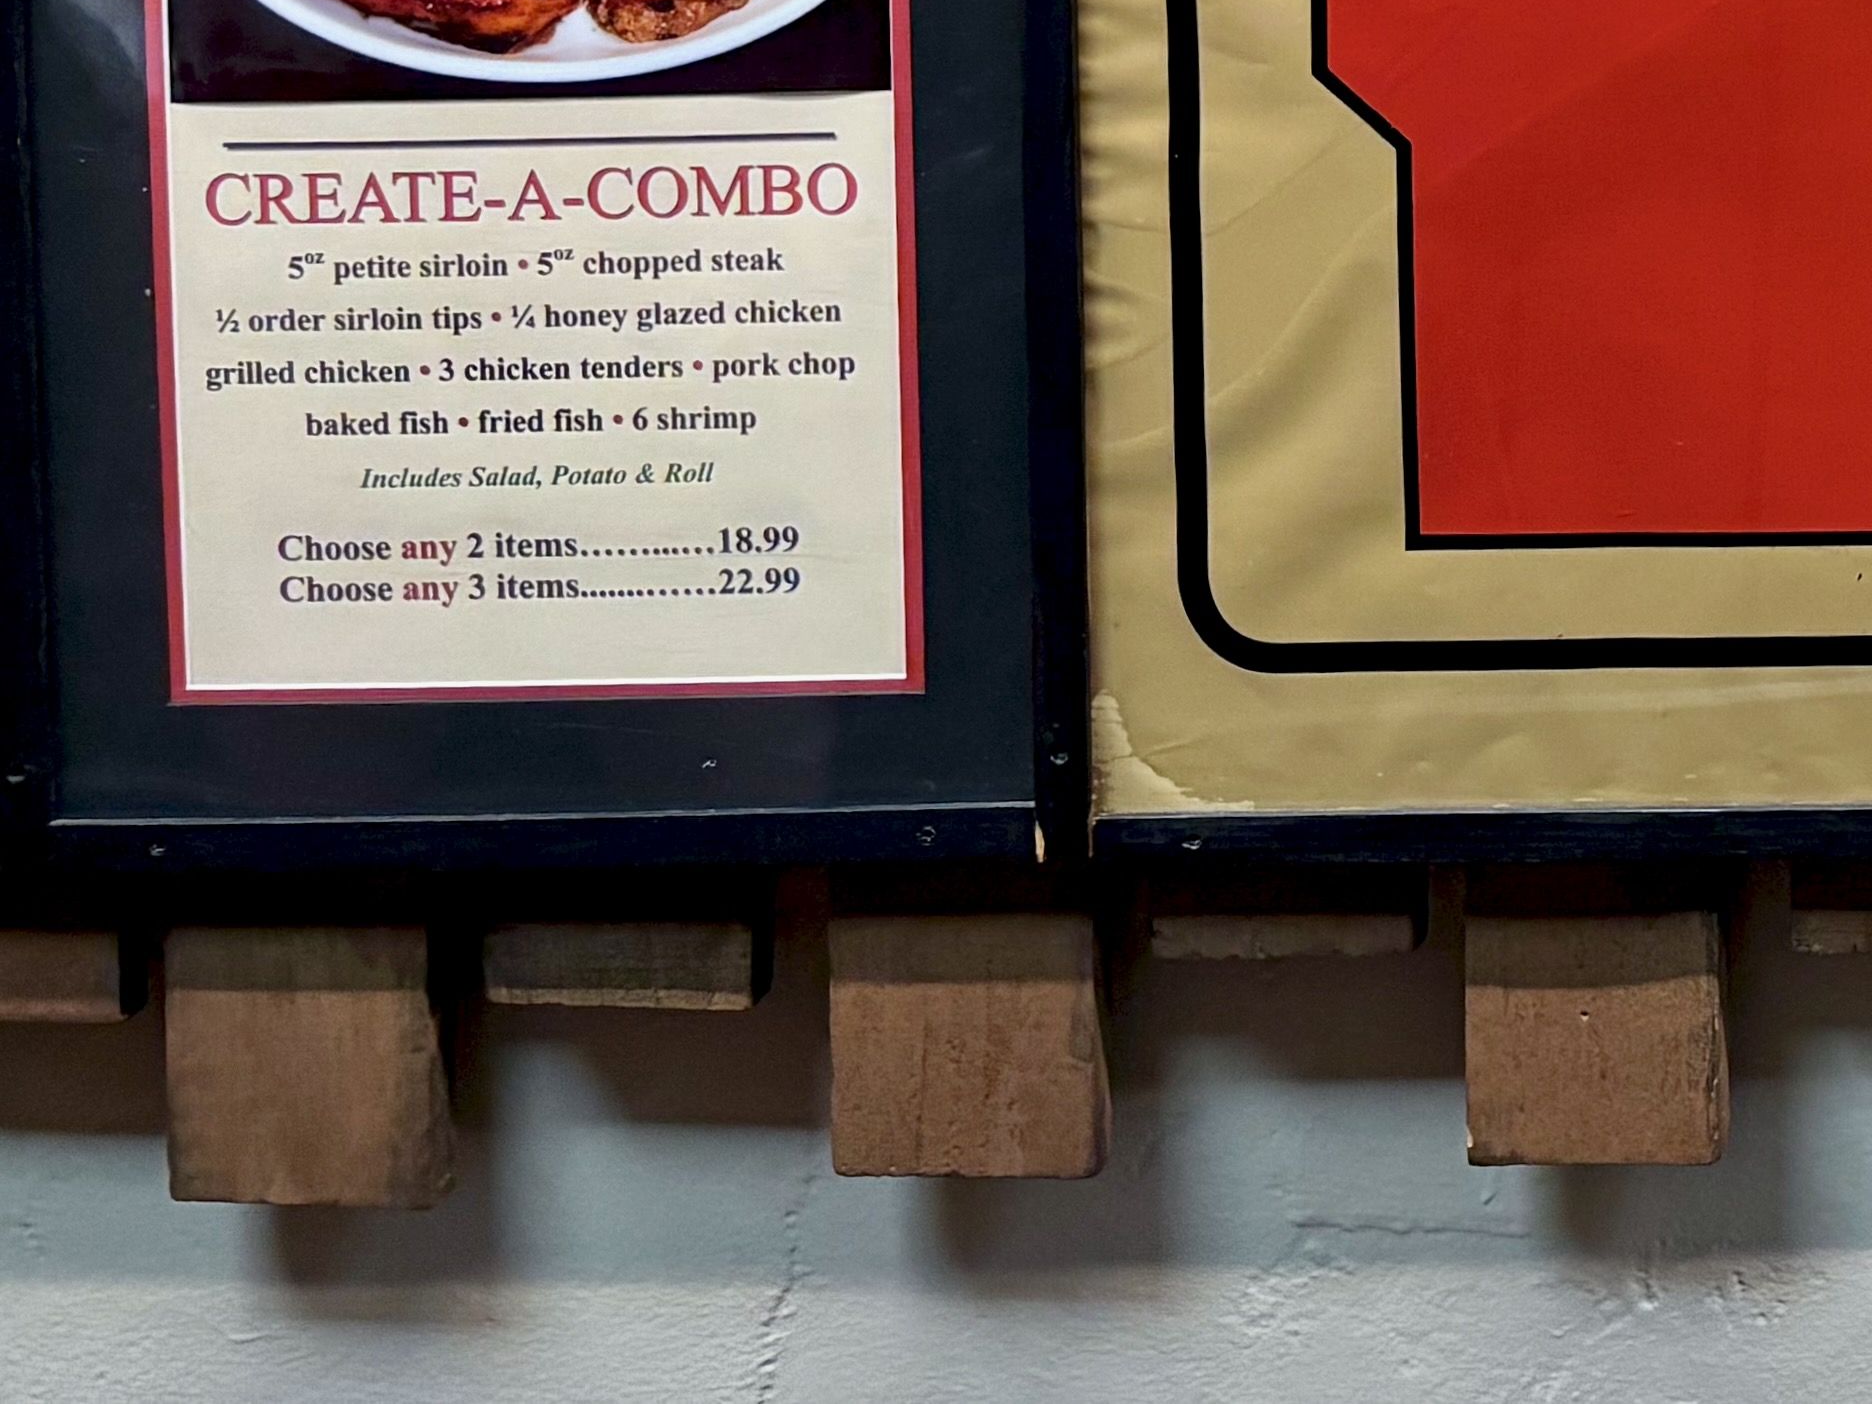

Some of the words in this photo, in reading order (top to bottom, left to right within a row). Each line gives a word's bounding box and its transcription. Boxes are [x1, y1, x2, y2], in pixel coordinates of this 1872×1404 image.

[205, 162, 858, 227] CREATE-A-COMBO
[333, 254, 412, 286] petite
[419, 252, 509, 278] sirloin
[582, 248, 702, 280] chopped
[711, 247, 785, 272] steak
[248, 308, 327, 333] order
[333, 306, 423, 331] sirloin
[431, 305, 483, 336] tips
[543, 303, 628, 333] honey
[636, 300, 726, 333] glazed
[734, 299, 842, 324] chicken
[205, 360, 296, 392] grilled
[304, 359, 411, 384] chicken
[464, 356, 571, 382] chicken
[580, 354, 684, 380] tenders
[712, 352, 781, 384] pork
[788, 351, 856, 381] chop
[305, 411, 391, 437] baked
[399, 410, 449, 435] fish
[478, 408, 545, 434] fried
[553, 408, 604, 433] fish
[656, 405, 757, 436] shrimp
[359, 466, 463, 489] Includes
[468, 465, 542, 490] Salad,
[550, 464, 627, 486] Potato
[663, 461, 715, 484] Roll
[277, 534, 392, 562] Choose
[401, 540, 458, 567] any
[466, 532, 485, 559] 2
